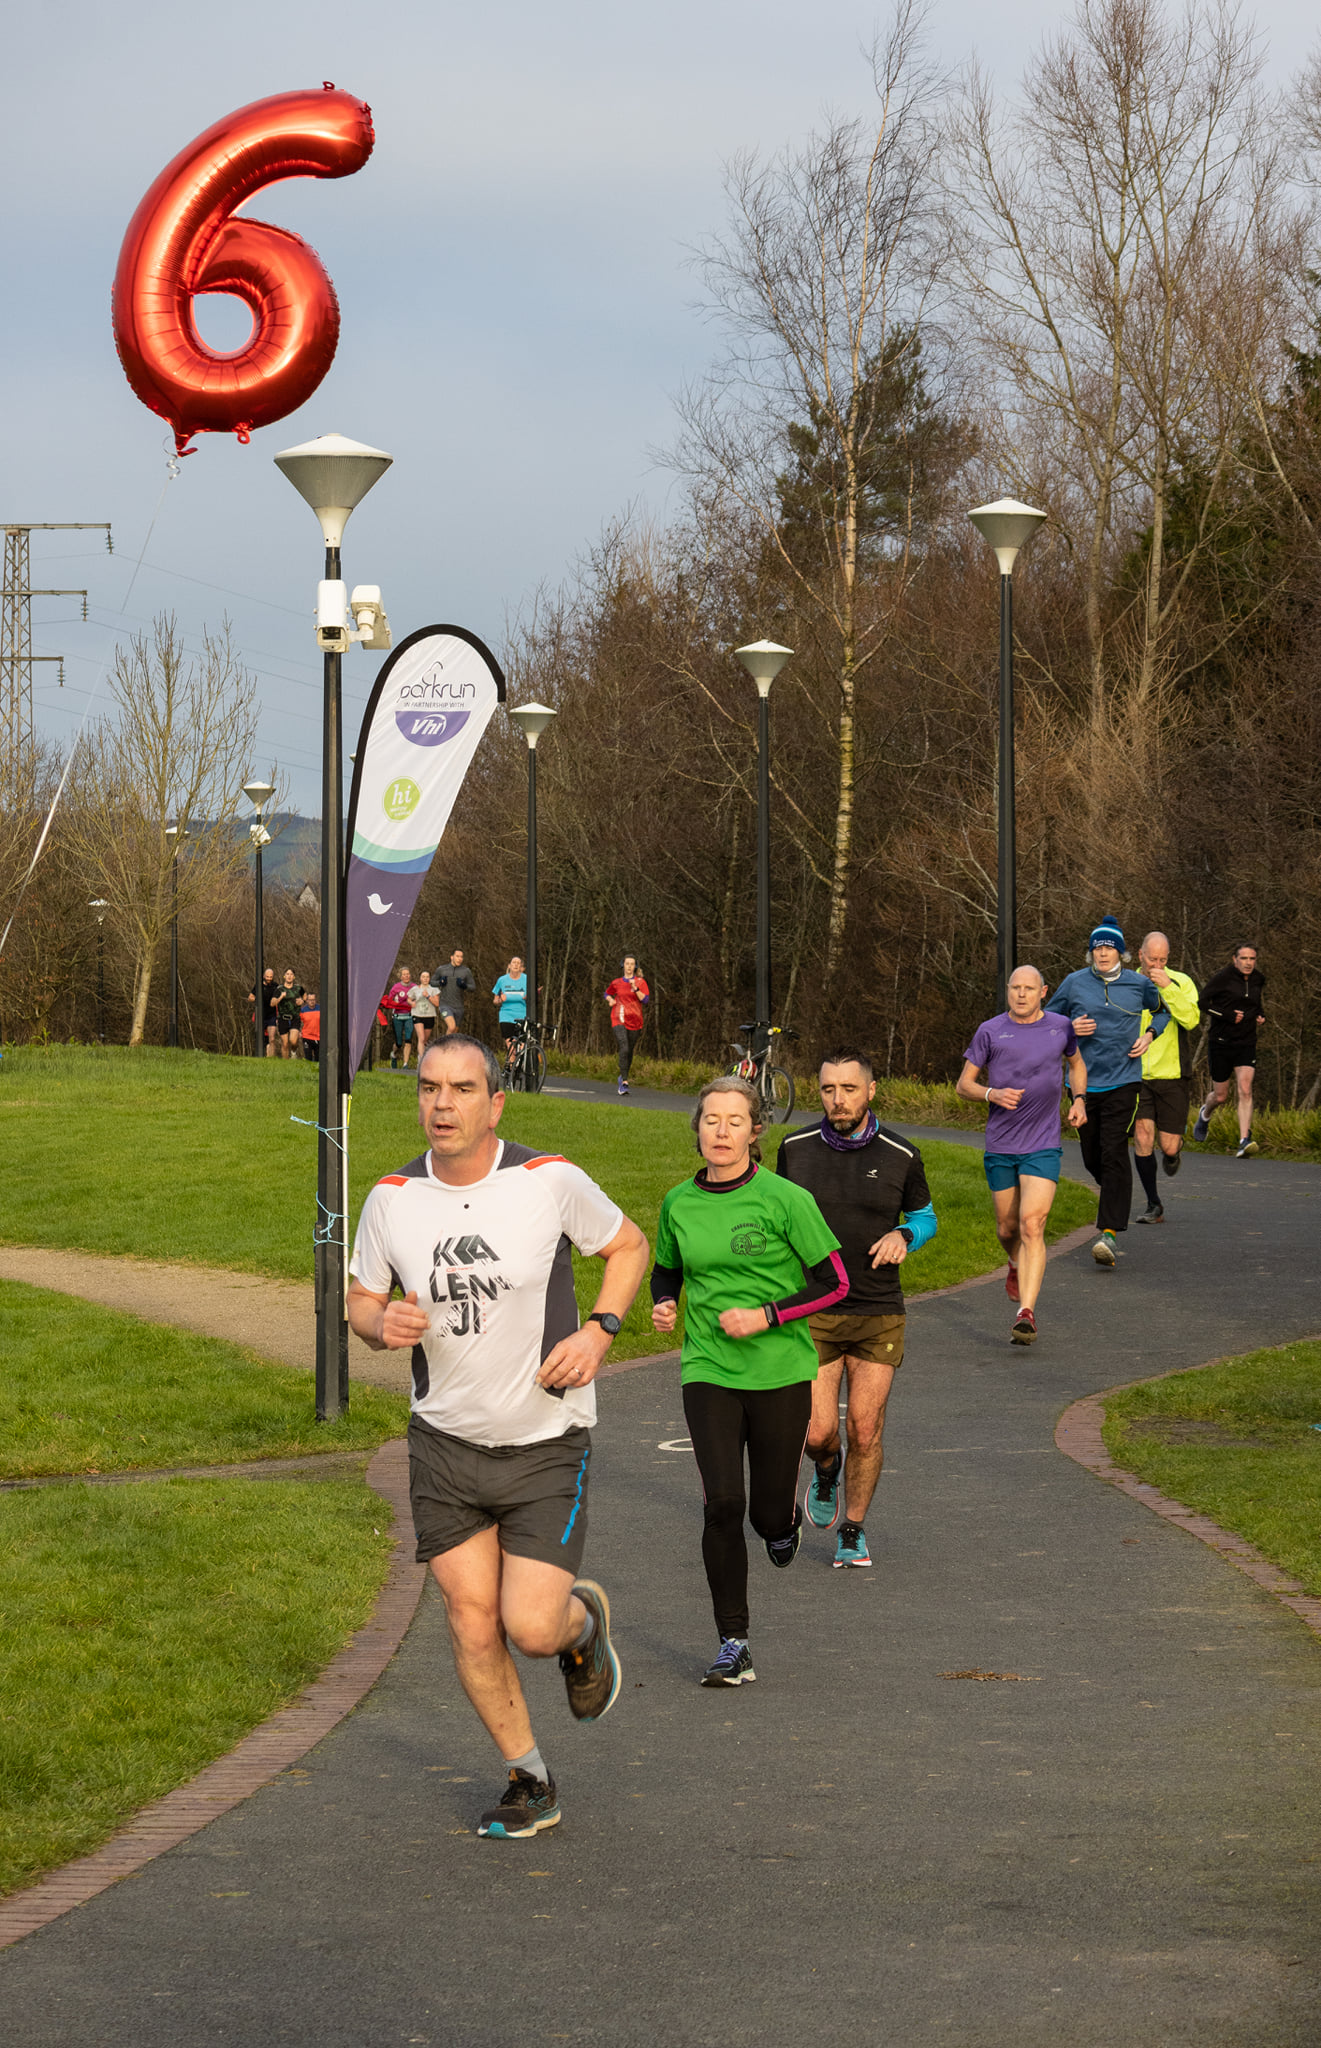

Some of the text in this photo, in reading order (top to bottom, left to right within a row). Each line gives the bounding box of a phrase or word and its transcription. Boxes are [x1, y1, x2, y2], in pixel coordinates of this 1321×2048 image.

[112, 82, 375, 457] 6
[397, 671, 476, 703] parkrun
[410, 717, 444, 735] Vhi
[391, 783, 412, 806] hi
